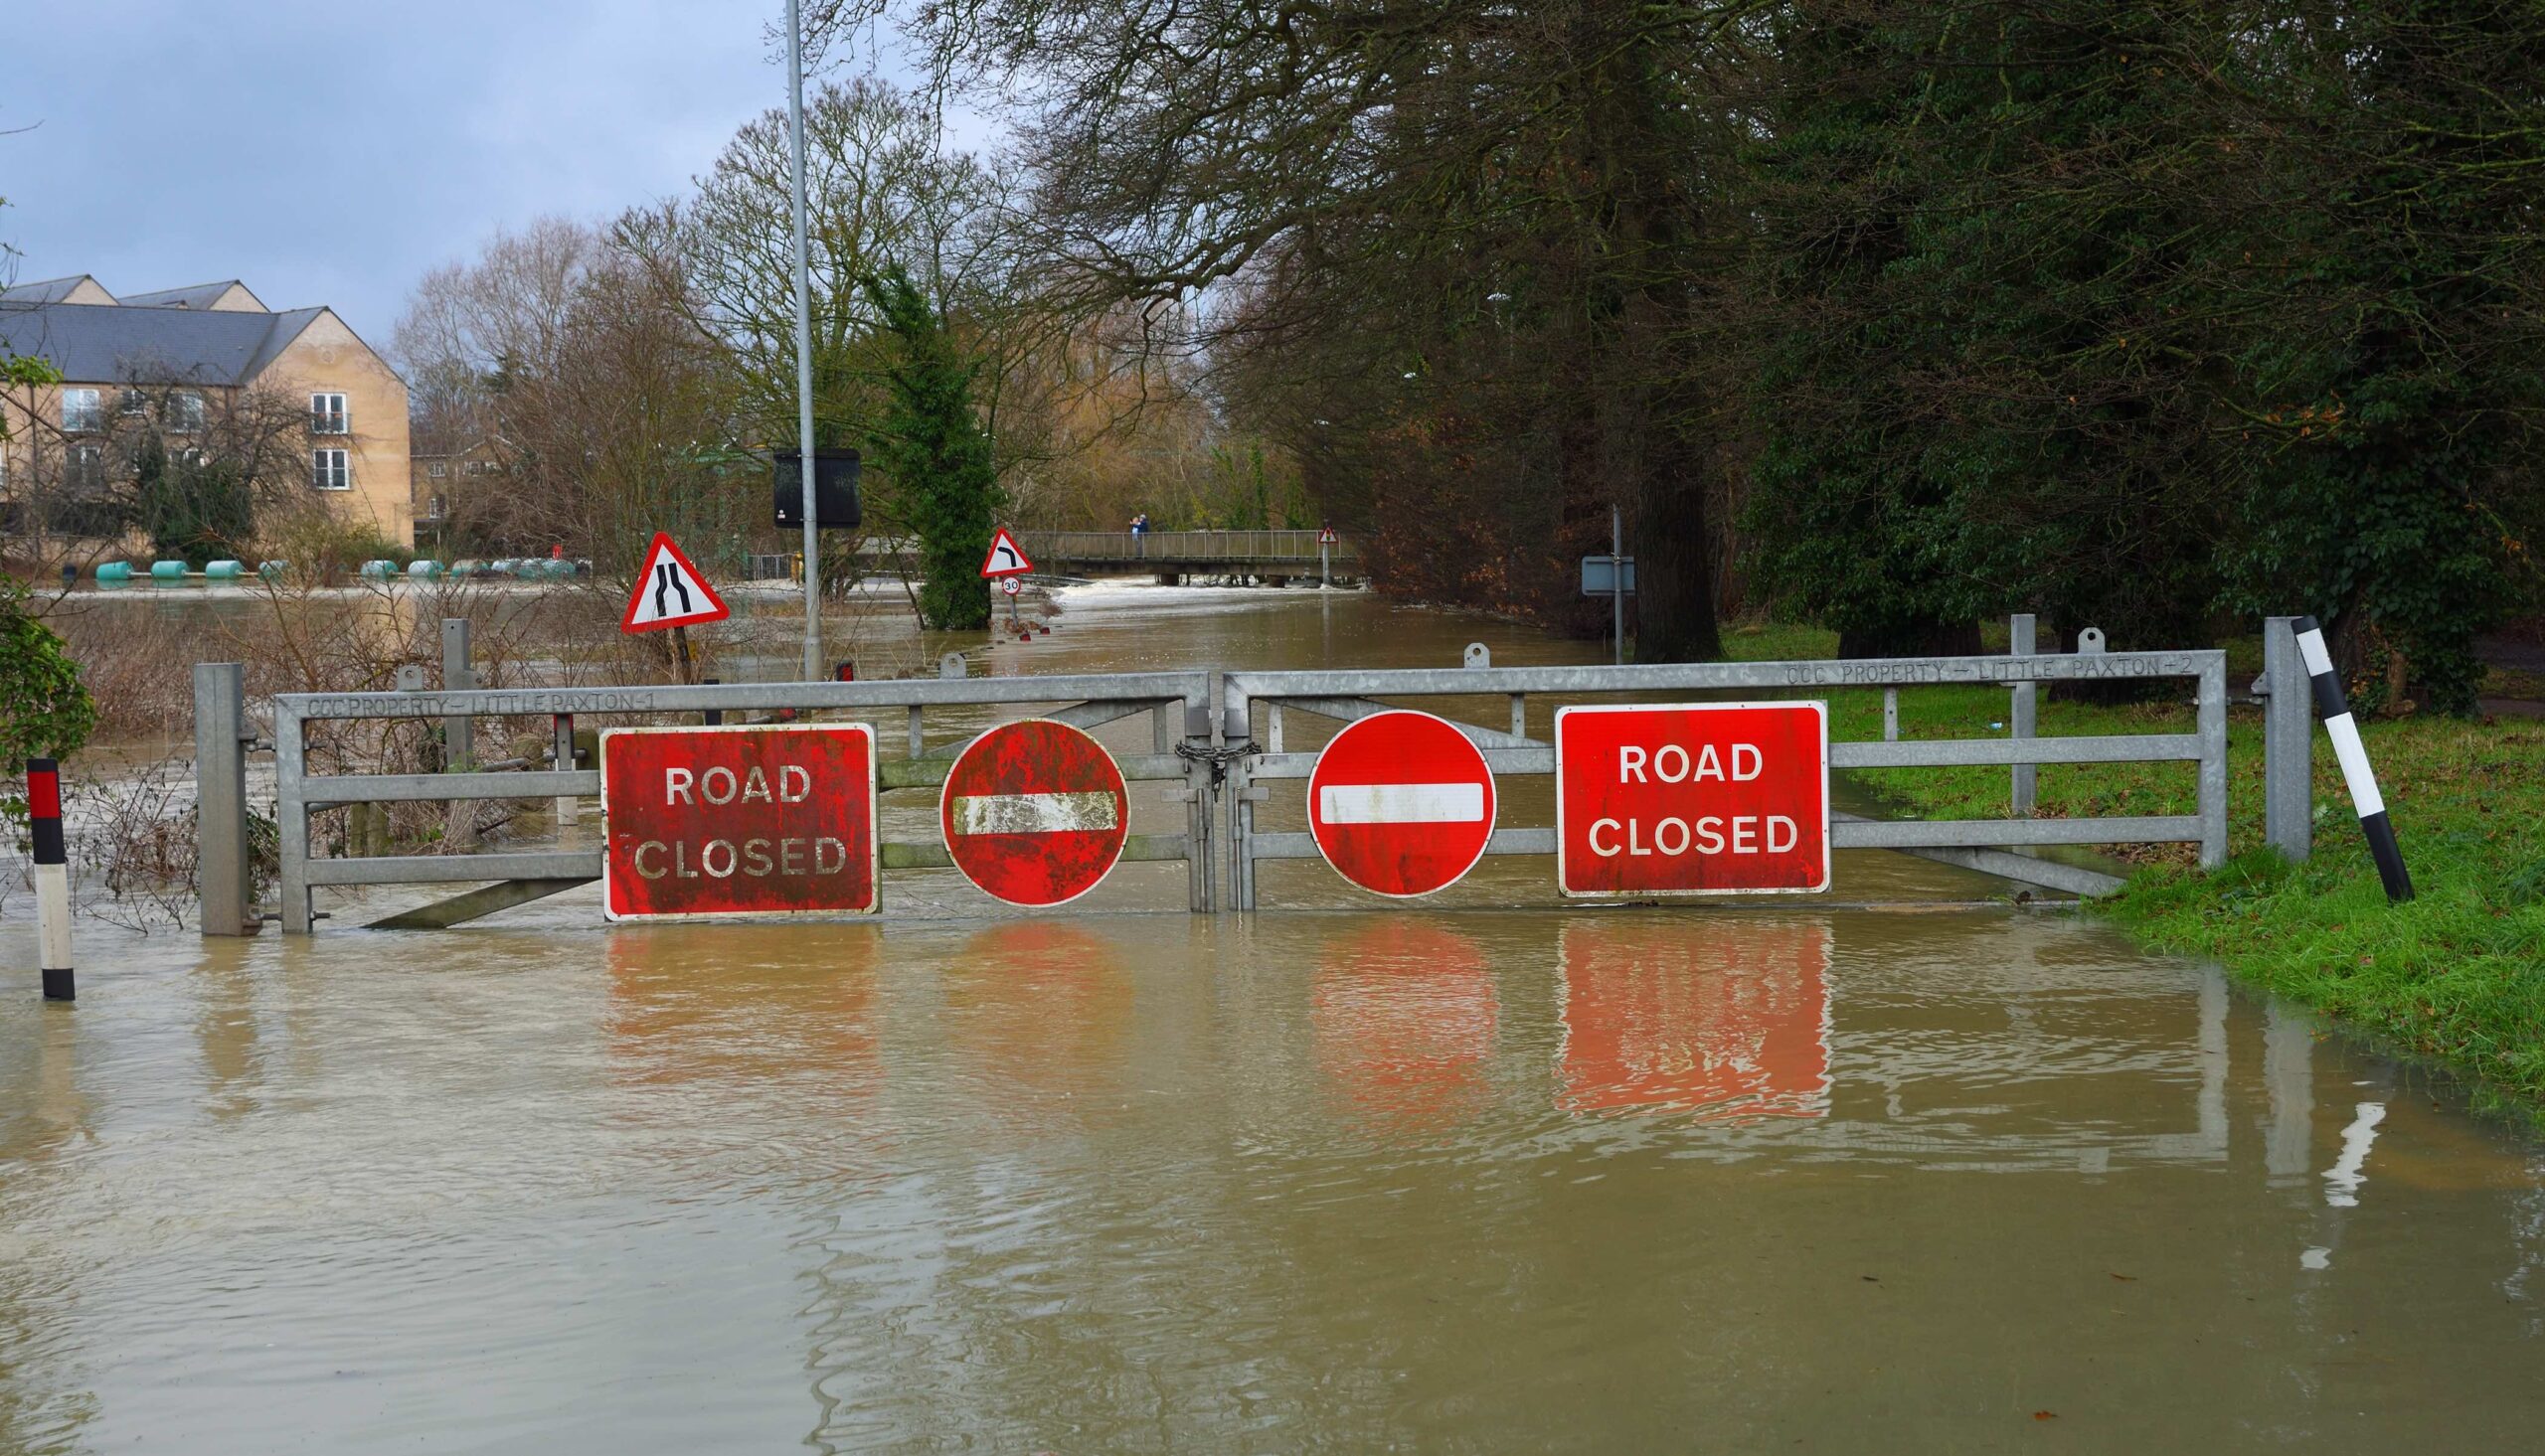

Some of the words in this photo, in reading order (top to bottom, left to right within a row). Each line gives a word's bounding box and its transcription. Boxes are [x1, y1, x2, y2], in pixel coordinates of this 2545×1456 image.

[1004, 580, 1019, 590] 30
[1786, 666, 1825, 684] CCC
[1842, 662, 1945, 683] PROPERTY
[1978, 660, 2055, 679] LITTLE
[308, 699, 344, 717] CCC
[349, 697, 448, 716] PROPERTY
[471, 694, 546, 714] LITTLE
[1619, 743, 1763, 783] ROAD
[665, 765, 811, 806] ROAD
[1589, 815, 1797, 857] CLOSED
[634, 837, 846, 880] CLOSED
